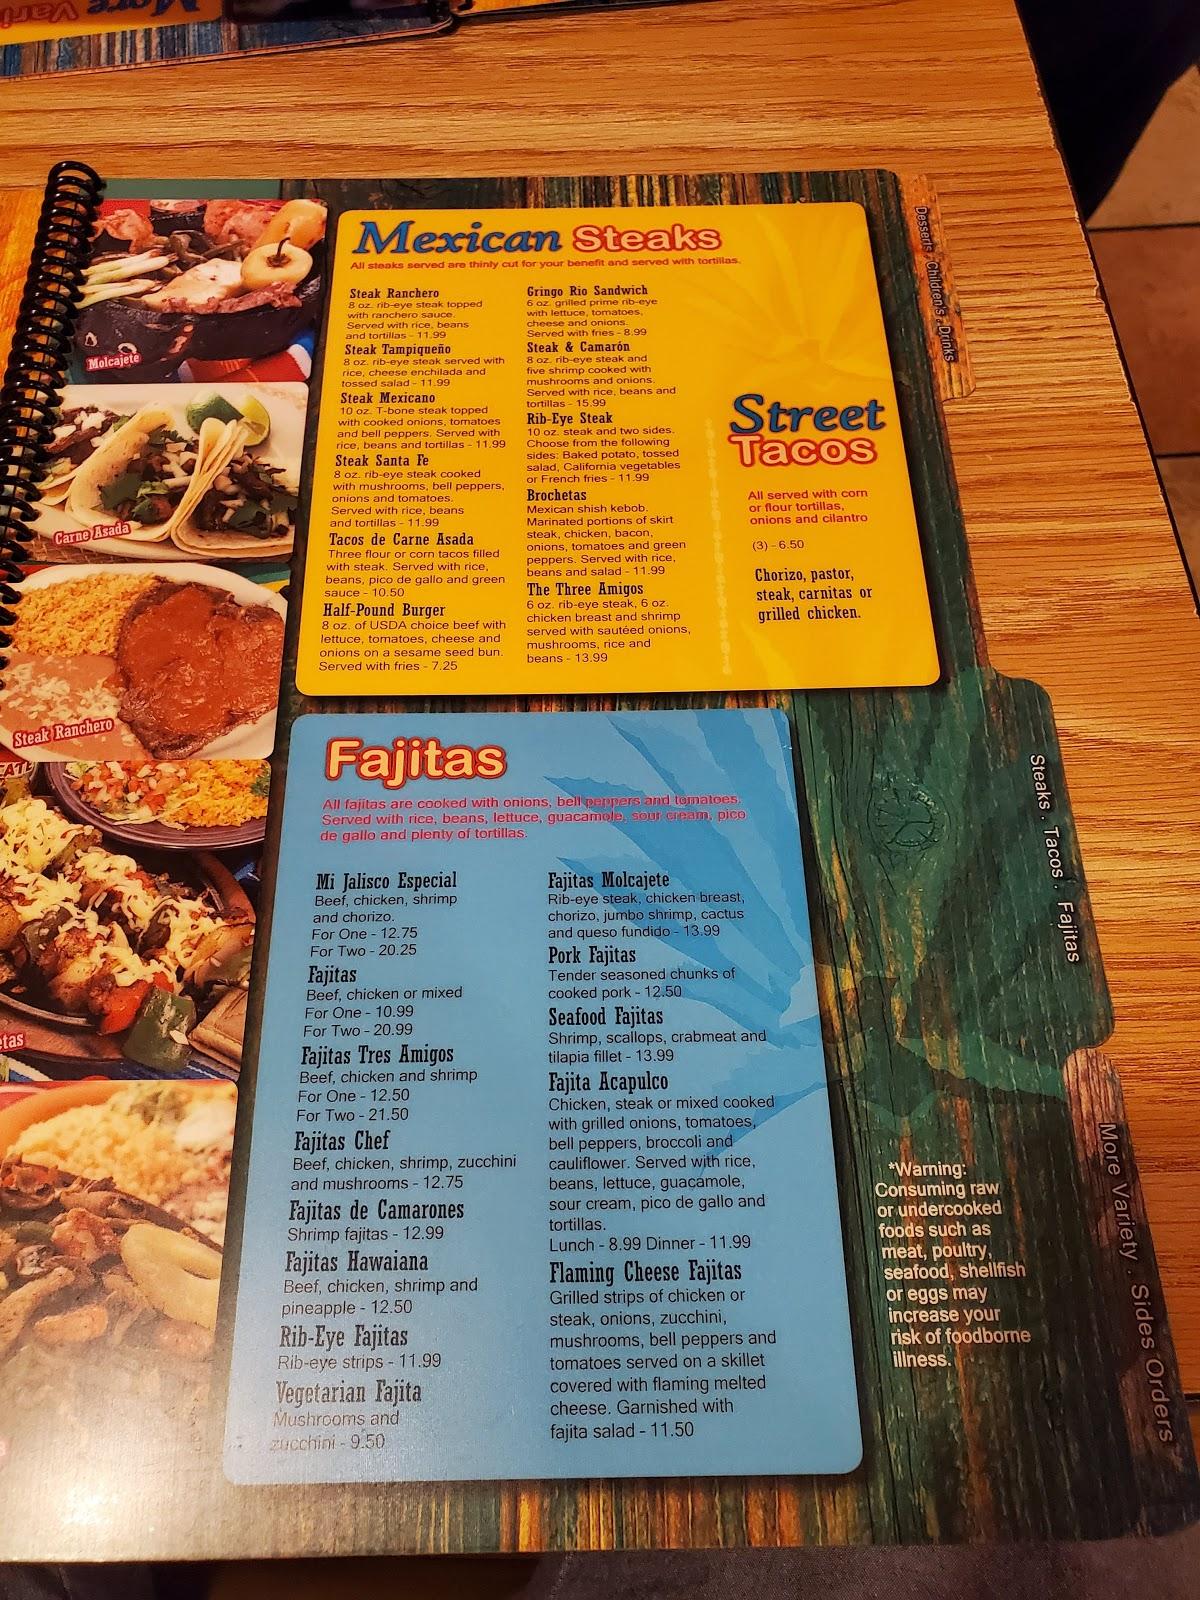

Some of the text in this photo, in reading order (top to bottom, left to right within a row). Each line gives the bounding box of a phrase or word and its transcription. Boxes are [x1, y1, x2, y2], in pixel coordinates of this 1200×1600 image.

[352, 220, 722, 254] Mexican Steaks
[350, 261, 365, 270] All
[367, 261, 404, 269] steaks
[407, 261, 445, 269] served
[469, 260, 499, 270] thinly
[501, 260, 518, 268] cut
[521, 259, 537, 267] for
[539, 260, 564, 269] your
[567, 258, 604, 267] benefit
[607, 258, 629, 266] and
[631, 257, 669, 266] served
[671, 257, 695, 265] with
[697, 256, 741, 265] tortillas.
[349, 287, 439, 298] Steak Ranchero
[527, 284, 648, 299] Gringo Rio Sandwich
[915, 207, 955, 362] Desserts Children's Drinks
[344, 343, 451, 357] Steak Tampiqueño
[527, 340, 630, 353] Steak & Camarón
[87, 354, 140, 370] Molcajete
[340, 391, 435, 404] Steak Mexicano
[526, 411, 613, 426] Rib-Eye Steak
[730, 393, 886, 434] Street
[728, 433, 877, 467] Tacos
[335, 453, 429, 467] Steak Santa Fe
[526, 488, 586, 501] Brochetas
[747, 488, 868, 500] All served with corn
[764, 502, 792, 512] flour
[795, 501, 844, 511] tortillas,
[749, 513, 868, 525] onions and cilantro
[54, 523, 129, 546] Carne Asada
[328, 532, 473, 546] Tacos de Carne Asada
[752, 540, 768, 552] (3)
[778, 539, 804, 549] 6.50
[755, 567, 854, 583] Chorizo, pastor,
[526, 581, 643, 597] The Three Amigos
[756, 585, 872, 603] steak, carnitas or
[322, 602, 446, 619] Half-Pound Burger
[758, 605, 861, 624] grilled chicken.
[13, 719, 113, 748] Steak Ranchero
[325, 737, 508, 790] Fajitas
[323, 795, 740, 810] All fajitas are cooked with onions, bell peppers and tomatoes.
[1030, 755, 1080, 963] Steaks Tacos Fajitas
[315, 870, 456, 893] Mi Jalisco Especial
[548, 870, 669, 892] Fajitas Molcajete
[314, 893, 457, 907] Beef, chicken, shrimp
[548, 945, 636, 966] Pork Fajitas
[307, 965, 357, 987] Fajitas
[549, 1005, 663, 1029] Seafood Fajitas
[0, 1033, 25, 1050] tas
[300, 1043, 453, 1069] Fajitas Tres Amigos
[548, 1070, 668, 1095] Fajita Acapulco
[293, 1129, 391, 1155] Fajitas Chef
[875, 1180, 999, 1199] Consuming raw
[288, 1198, 464, 1225] Fajitas de Camarones
[877, 1199, 1002, 1217] or undercooked
[878, 1221, 991, 1238] foods such as
[881, 1241, 992, 1261] meat, poultry,
[285, 1249, 428, 1277] Fajitas Hawaiana
[884, 1261, 1025, 1281] seafood, shellfish
[549, 1258, 741, 1287] Flaming Cheese Fajitas
[1100, 1123, 1173, 1442] More Variety Sides Orders
[886, 1287, 987, 1305] or eggs may
[888, 1306, 1000, 1326] increase your
[279, 1323, 408, 1352] Rib-Eye Fajitas
[890, 1326, 1031, 1344] risk of foodborne
[892, 1350, 951, 1367] illness.
[276, 1378, 422, 1408] Vegetarian Fajita
